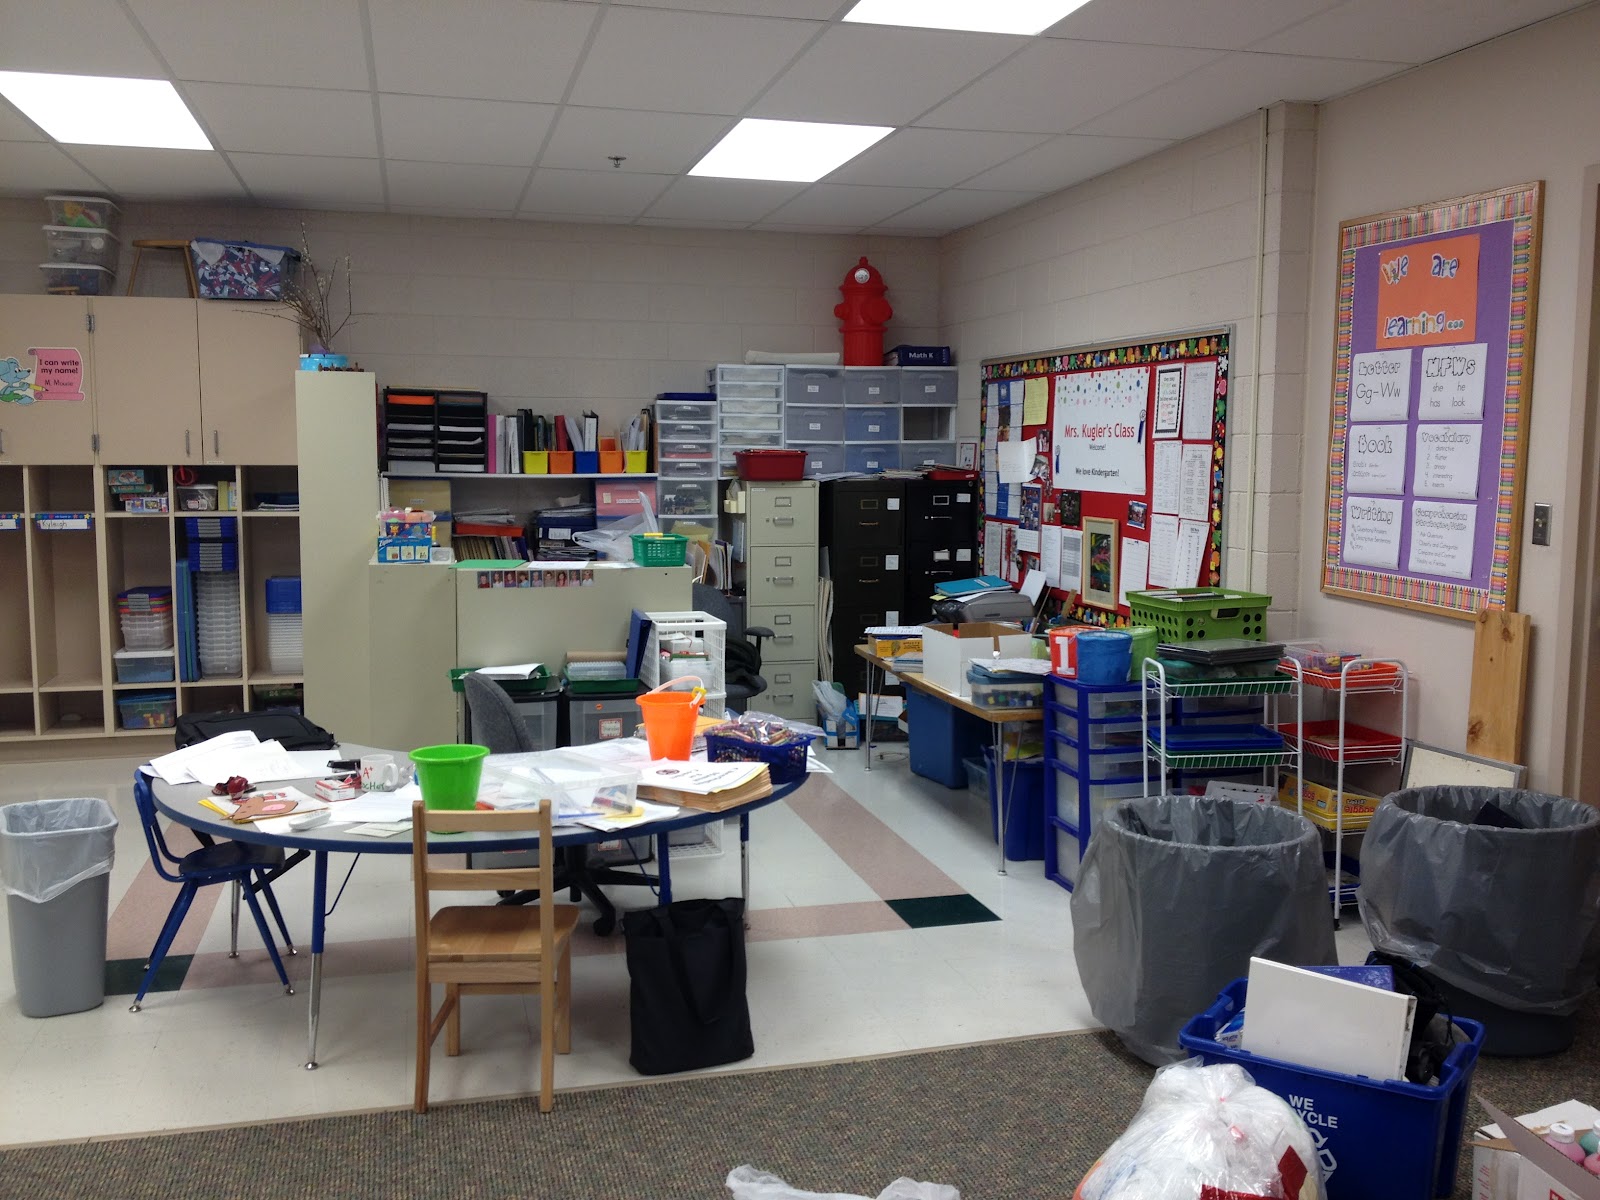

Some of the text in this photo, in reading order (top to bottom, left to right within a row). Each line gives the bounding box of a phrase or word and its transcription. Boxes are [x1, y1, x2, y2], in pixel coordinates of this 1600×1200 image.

[1381, 254, 1459, 284] We are
[1358, 360, 1401, 376] Letter
[1432, 381, 1466, 393] she he
[1429, 397, 1466, 408] has look
[1064, 423, 1135, 441] Mrs. Kugler's Class
[1089, 443, 1107, 451] Welcome!
[1358, 434, 1393, 455] Book
[1075, 467, 1120, 478] We love Kindergarten!
[1350, 505, 1394, 525] Writing
[1288, 1094, 1314, 1111] WE
[1297, 1109, 1338, 1129] YCLE
